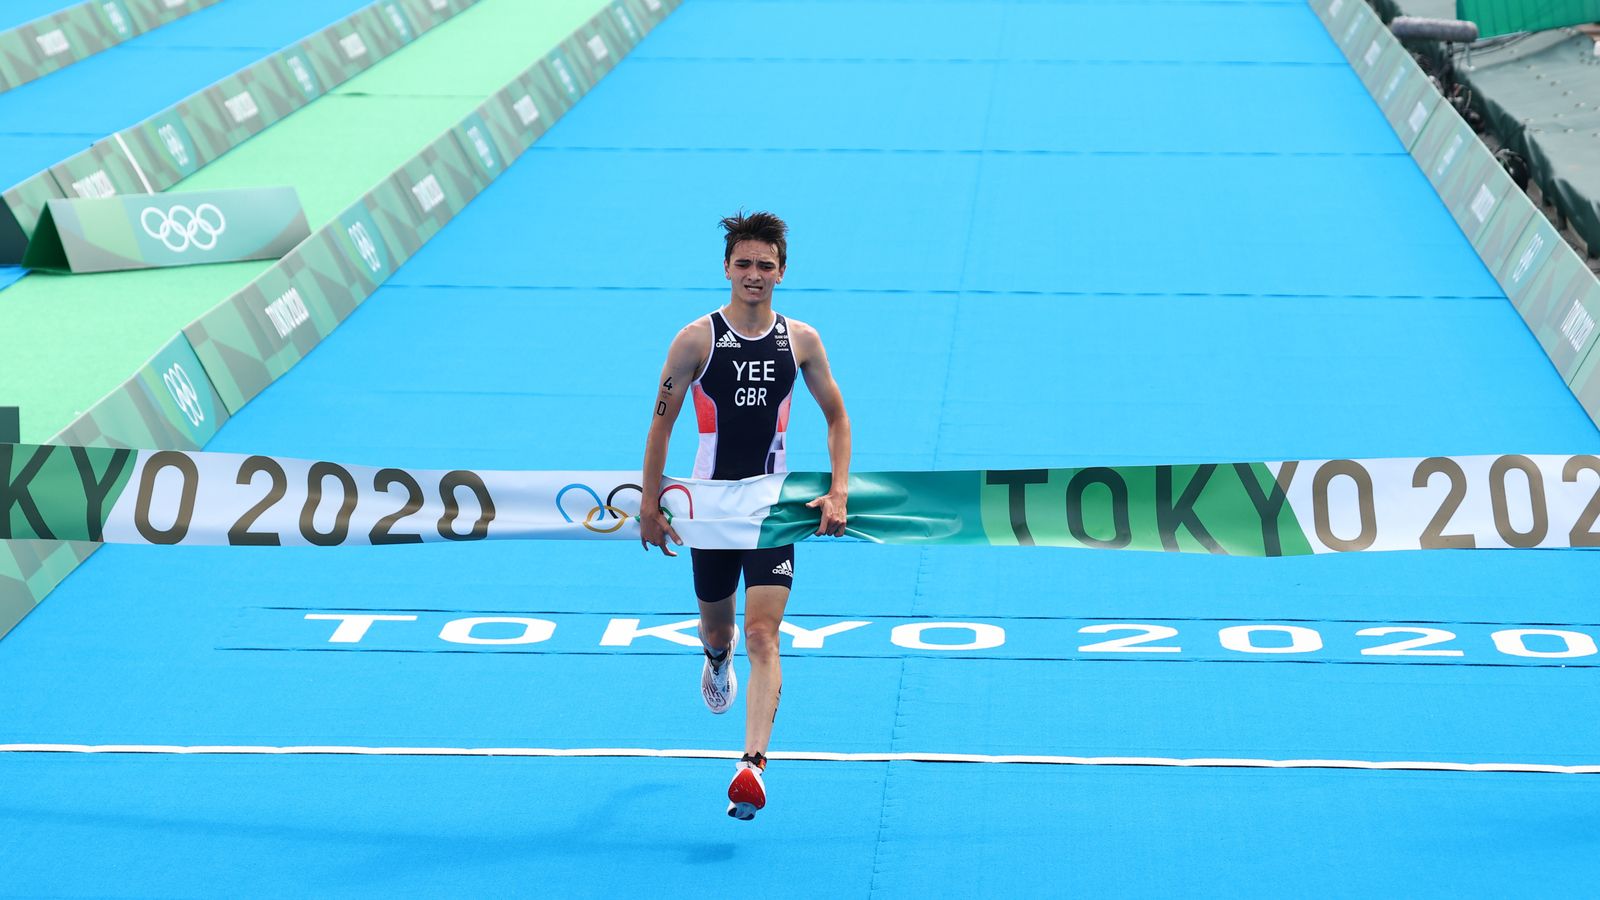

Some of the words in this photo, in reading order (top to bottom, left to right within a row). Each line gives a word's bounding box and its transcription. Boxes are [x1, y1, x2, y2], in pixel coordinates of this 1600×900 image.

[663, 376, 673, 390] 4
[732, 360, 775, 381] YEE
[734, 388, 767, 406] GBR
[0, 444, 199, 545] KYO
[228, 455, 496, 546] 2020
[986, 459, 1377, 557] TOKYO
[1411, 454, 1600, 550] 202
[303, 613, 1006, 651] TOKYO
[1077, 623, 1598, 658] 2020
